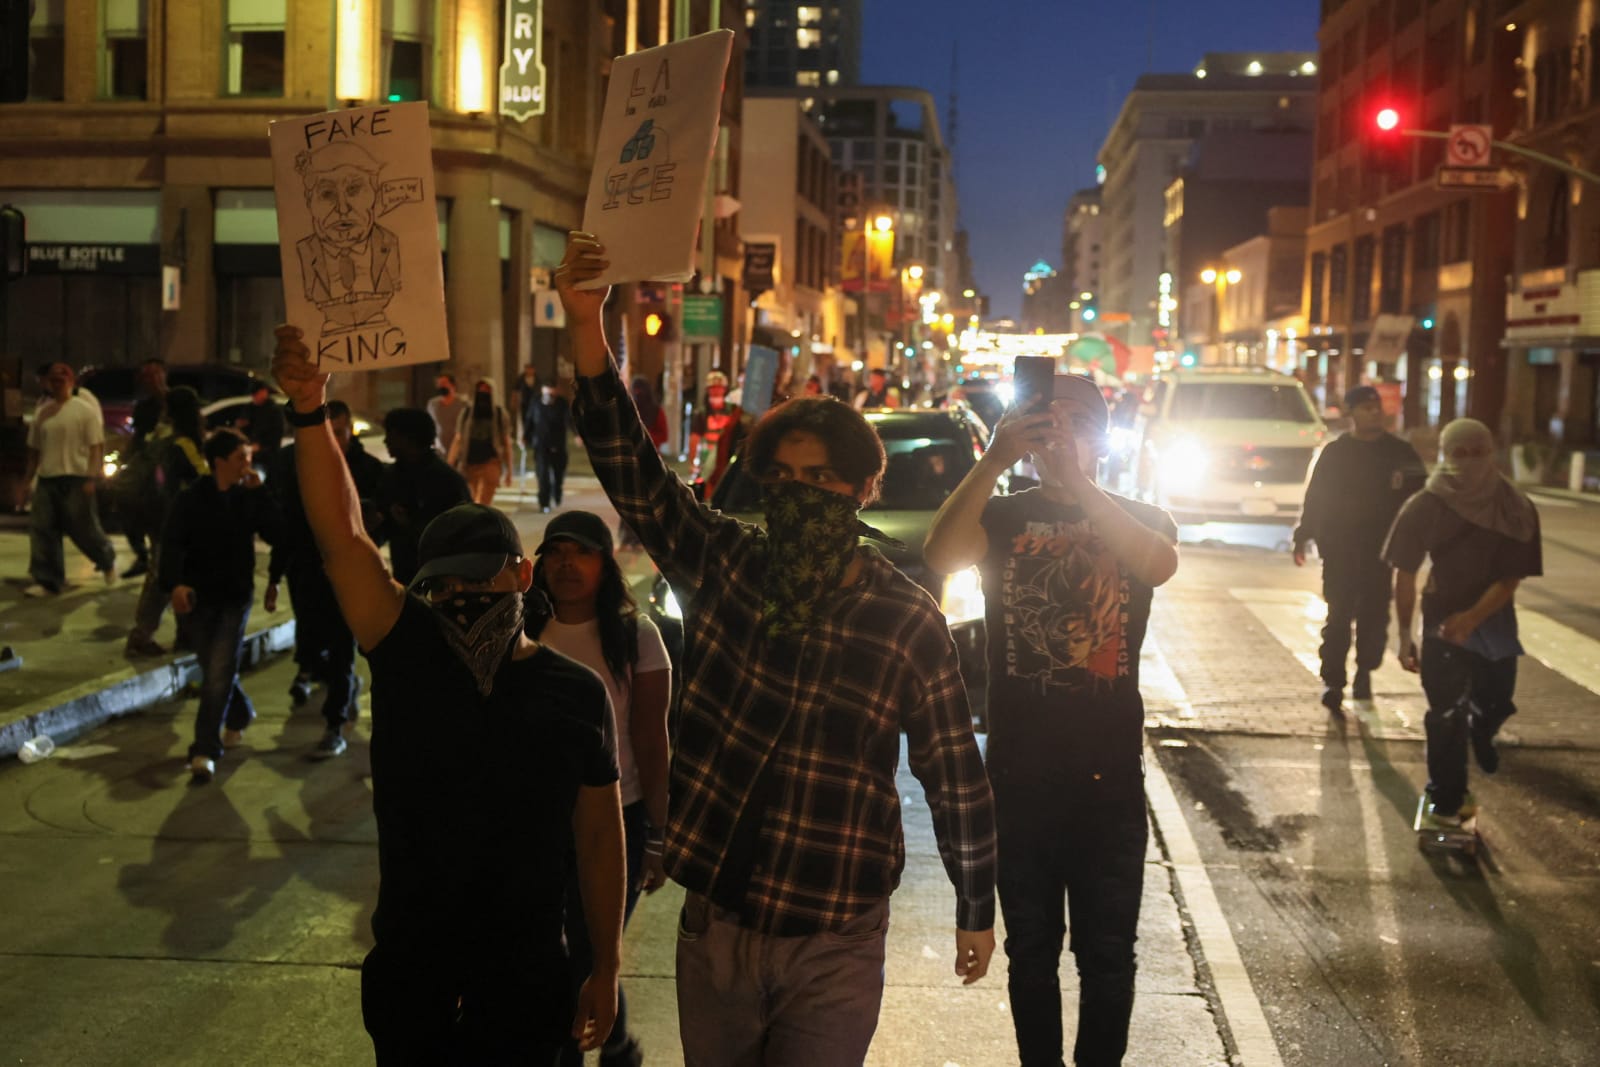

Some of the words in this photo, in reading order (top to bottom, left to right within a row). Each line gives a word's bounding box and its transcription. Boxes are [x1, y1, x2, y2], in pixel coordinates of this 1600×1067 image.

[512, 0, 534, 75] RY
[503, 85, 542, 102] BLDG
[629, 58, 671, 98] LA
[304, 109, 392, 149] FAKE
[602, 162, 677, 211] ICE
[30, 247, 65, 260] BLUE
[70, 247, 124, 261] BOTTLE
[316, 327, 408, 367] KING
[1004, 613, 1017, 677] BLACK
[1118, 612, 1129, 677] BLACK
